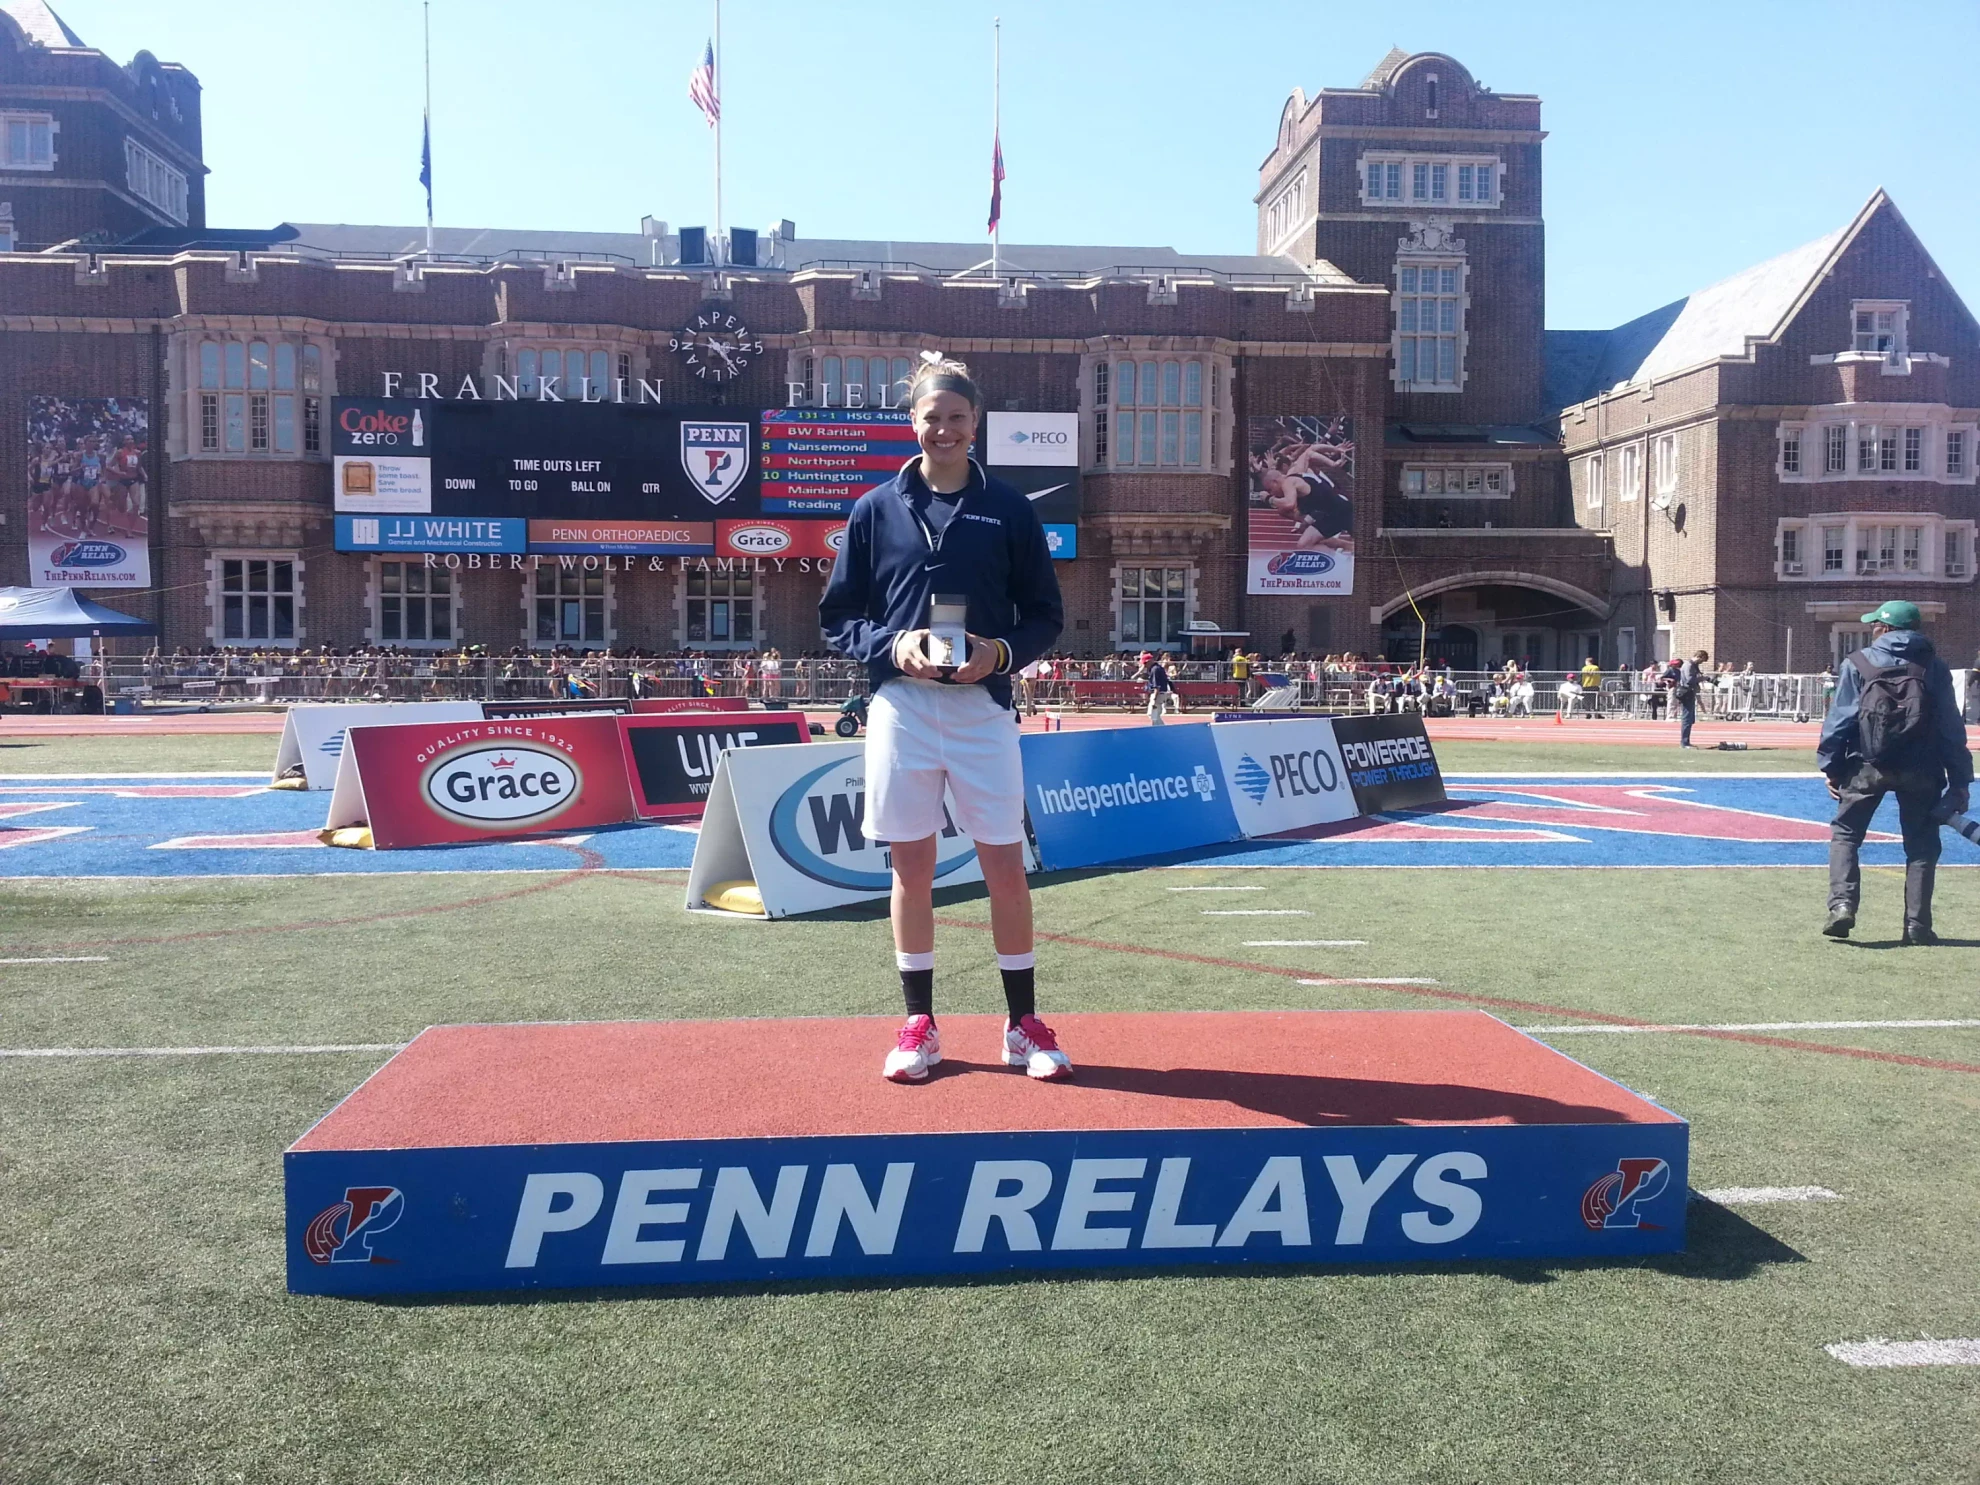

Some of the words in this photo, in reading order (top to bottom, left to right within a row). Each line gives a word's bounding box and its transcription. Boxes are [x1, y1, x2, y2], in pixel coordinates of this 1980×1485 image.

[381, 371, 664, 405] FRANKLIN
[785, 381, 900, 410] FIEL
[340, 408, 409, 433] Coke
[847, 412, 872, 420] HSG
[351, 432, 398, 445] zero
[687, 427, 742, 442] PENN
[763, 427, 770, 435] 7
[788, 427, 812, 436] BW
[817, 428, 866, 437] Raritan
[1031, 431, 1067, 444] PECO
[762, 442, 770, 450] 8
[788, 443, 867, 452] Nansemond
[513, 459, 540, 471] TIME
[543, 460, 572, 472] OUTS
[576, 460, 602, 472] LEFT
[762, 457, 770, 465] 9
[788, 457, 856, 467] Northport
[763, 471, 779, 480] 10
[788, 471, 863, 482] Huntington
[445, 478, 476, 490] DOWN
[509, 479, 522, 491] TO
[524, 480, 538, 491] GO
[571, 481, 595, 492] BALL
[597, 482, 611, 492] ON
[642, 483, 660, 494] QTR
[788, 486, 849, 495] Mainland
[788, 500, 841, 510] Reading
[388, 521, 415, 538] JJ
[424, 521, 502, 539] WHITE
[552, 529, 587, 541] PENN
[592, 529, 690, 541] ORTHOPAEDICS
[737, 534, 782, 546] Grace
[424, 552, 544, 570] ROBERT
[558, 554, 636, 572] WOLF
[648, 555, 664, 571] &
[680, 555, 788, 573] FAMILY
[417, 727, 479, 763] QUALITY
[487, 726, 533, 737] SINCE
[541, 731, 574, 753] 1922
[677, 731, 758, 778] LIM
[1342, 735, 1431, 769] POWERADE
[1269, 749, 1338, 799] PECO
[1351, 768, 1388, 788] POWER
[1388, 761, 1436, 782] THROUGH
[446, 771, 561, 803] Grace
[1036, 772, 1189, 817] Independence
[504, 1162, 915, 1269] PENN
[952, 1151, 1488, 1253] RELAYS
